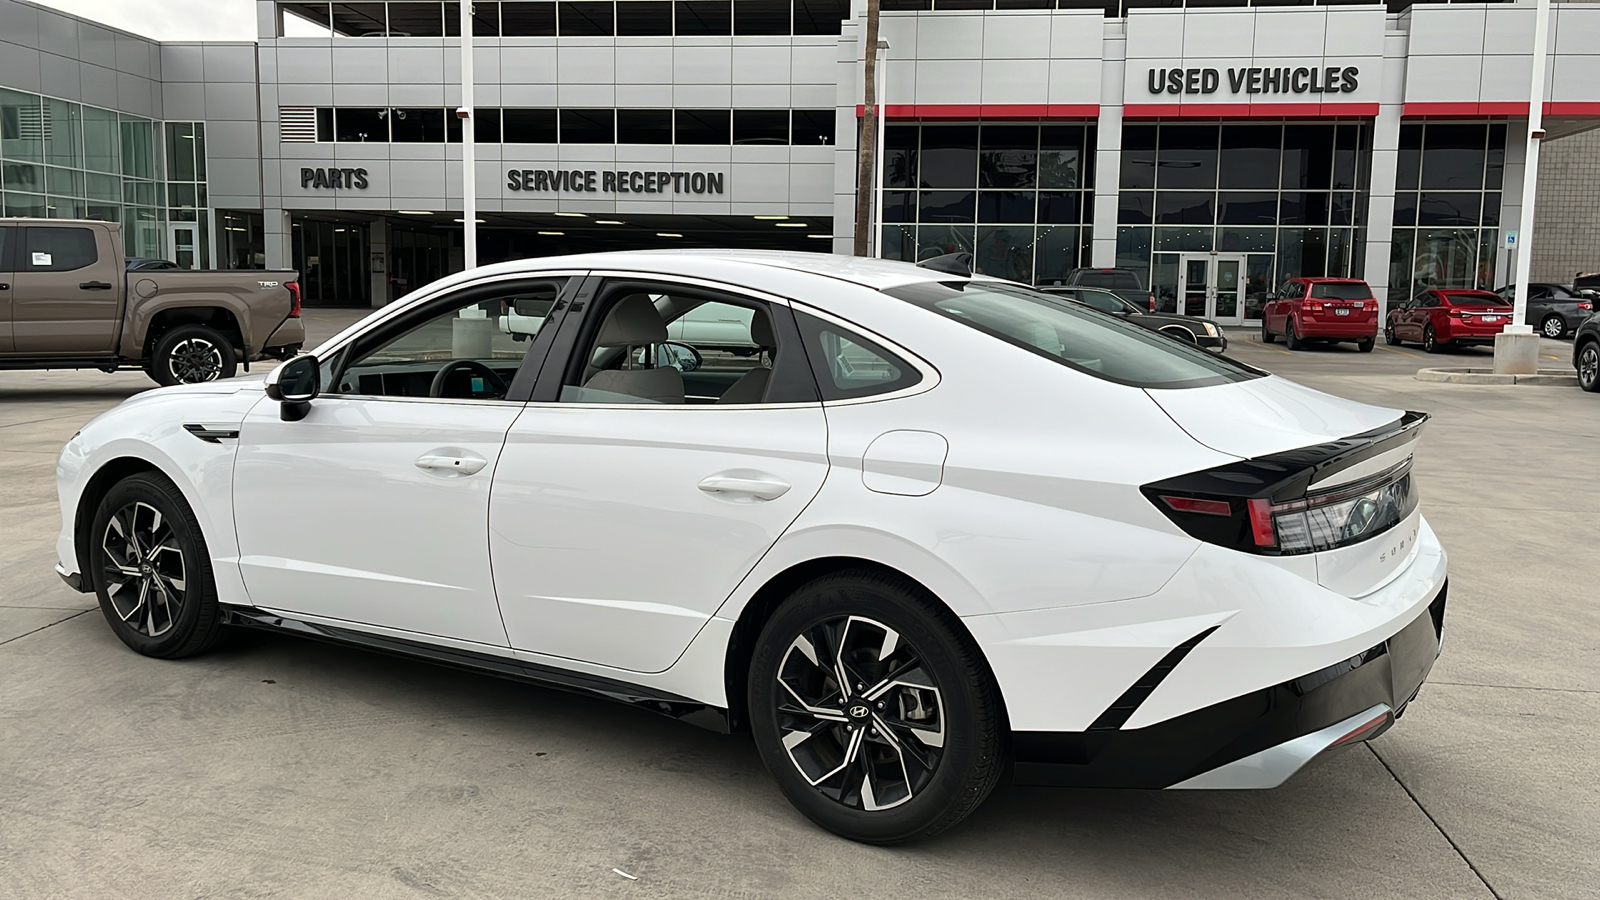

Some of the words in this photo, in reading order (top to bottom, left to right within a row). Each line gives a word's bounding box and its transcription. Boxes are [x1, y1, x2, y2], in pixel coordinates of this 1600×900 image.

[1149, 68, 1219, 94] USED
[1228, 67, 1359, 94] VEHICLES
[300, 167, 368, 189] PARTS
[507, 169, 597, 192] SERVICE
[602, 171, 723, 194] RECEPTION
